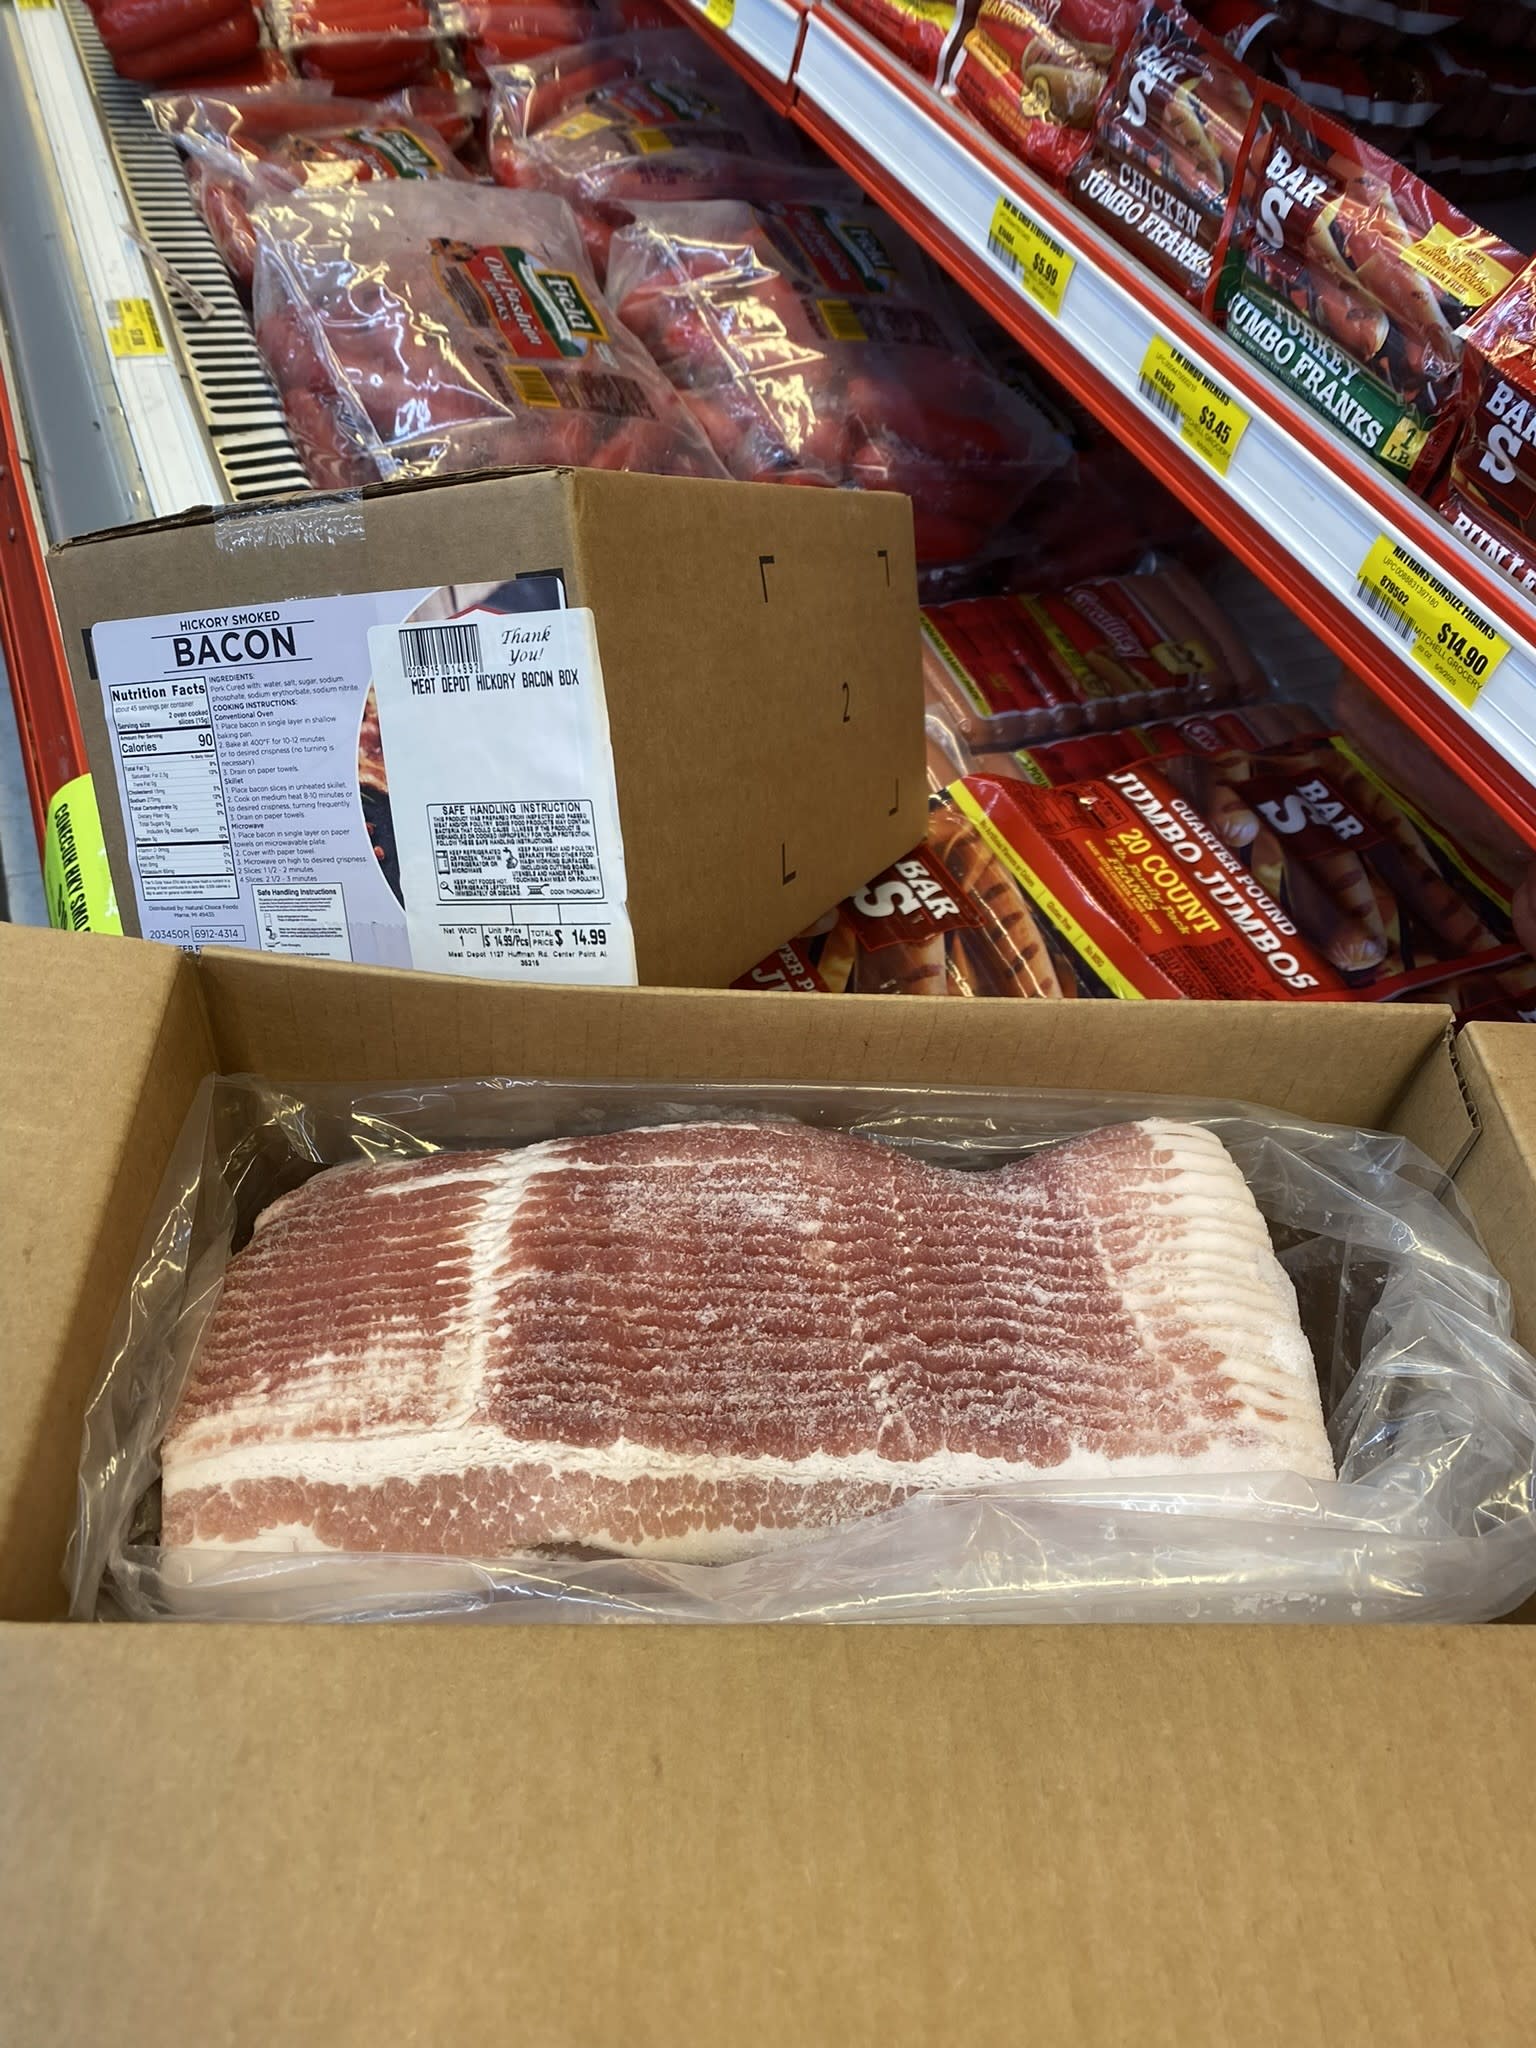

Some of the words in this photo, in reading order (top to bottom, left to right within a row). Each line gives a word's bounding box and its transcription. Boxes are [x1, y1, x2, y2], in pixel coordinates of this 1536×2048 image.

[1266, 145, 1328, 208] BAR
[1080, 168, 1145, 224] JUMBO
[1118, 163, 1201, 238] CHICKEN
[1256, 187, 1294, 249] S
[482, 255, 507, 287] Old
[1033, 252, 1058, 286] $5.99
[547, 279, 593, 330] Field
[1272, 299, 1361, 386] TURKEY
[1291, 352, 1384, 449] FRANKS
[1200, 406, 1231, 444] $3.45
[1401, 427, 1416, 449] 1
[1387, 445, 1411, 467] LB.
[1479, 424, 1523, 484] S
[1380, 575, 1409, 606] 879502
[1393, 546, 1432, 581] NATHANS
[1461, 605, 1497, 640] FRANKS
[180, 616, 228, 630] HICKORY
[232, 610, 280, 625] SMOKED
[502, 625, 551, 645] Thank
[173, 626, 296, 667] BACON
[508, 649, 543, 666] You!
[1437, 623, 1488, 676] $14.90
[209, 673, 254, 683] INGREDIENTS:
[319, 676, 343, 684] sodium
[411, 678, 435, 695] MEAT
[442, 675, 470, 693] DEPOT
[477, 674, 516, 691] HICKORY
[522, 671, 554, 688] BACON
[559, 669, 579, 685] BOX
[1448, 656, 1482, 691] GROCERY
[112, 687, 166, 701] Nutrition
[172, 683, 205, 696] Facts
[213, 703, 244, 712] COOKING
[246, 699, 297, 709] INSTRUCTIONS:
[248, 692, 270, 700] sodium
[313, 686, 337, 694] sodium
[842, 682, 850, 723] 2
[214, 711, 255, 721] Conventional
[122, 742, 157, 753] Calories
[198, 733, 212, 746] 90
[226, 740, 241, 748] Bake
[442, 805, 465, 815] SAFE
[470, 804, 516, 814] HANDLING
[521, 802, 581, 813] INSTRUCTION
[1256, 795, 1331, 833] S
[1296, 780, 1364, 840] BAR
[55, 803, 79, 870] CONECUH
[232, 822, 264, 830] Microwave
[243, 848, 261, 856] Cover
[1170, 800, 1242, 874] QUARTER
[1235, 873, 1297, 937] POUND
[65, 864, 83, 897] HKY
[272, 888, 299, 896] Handling
[300, 888, 337, 896] Instructions
[895, 860, 960, 920] BAR
[1107, 772, 1203, 864] JUMBO
[1194, 870, 1320, 990] JUMBOS
[1107, 857, 1158, 910] FRANKS
[1117, 828, 1151, 855] 20
[1142, 854, 1221, 933] COUNT
[71, 893, 91, 932] SMO
[853, 881, 922, 918] S
[194, 928, 239, 938] 6912-4314
[1161, 906, 1190, 934] Pack
[460, 936, 464, 947] 1
[485, 935, 490, 947] $
[495, 935, 529, 947] 14.99/Pcs
[555, 929, 563, 947] $
[572, 929, 607, 945] 14.99
